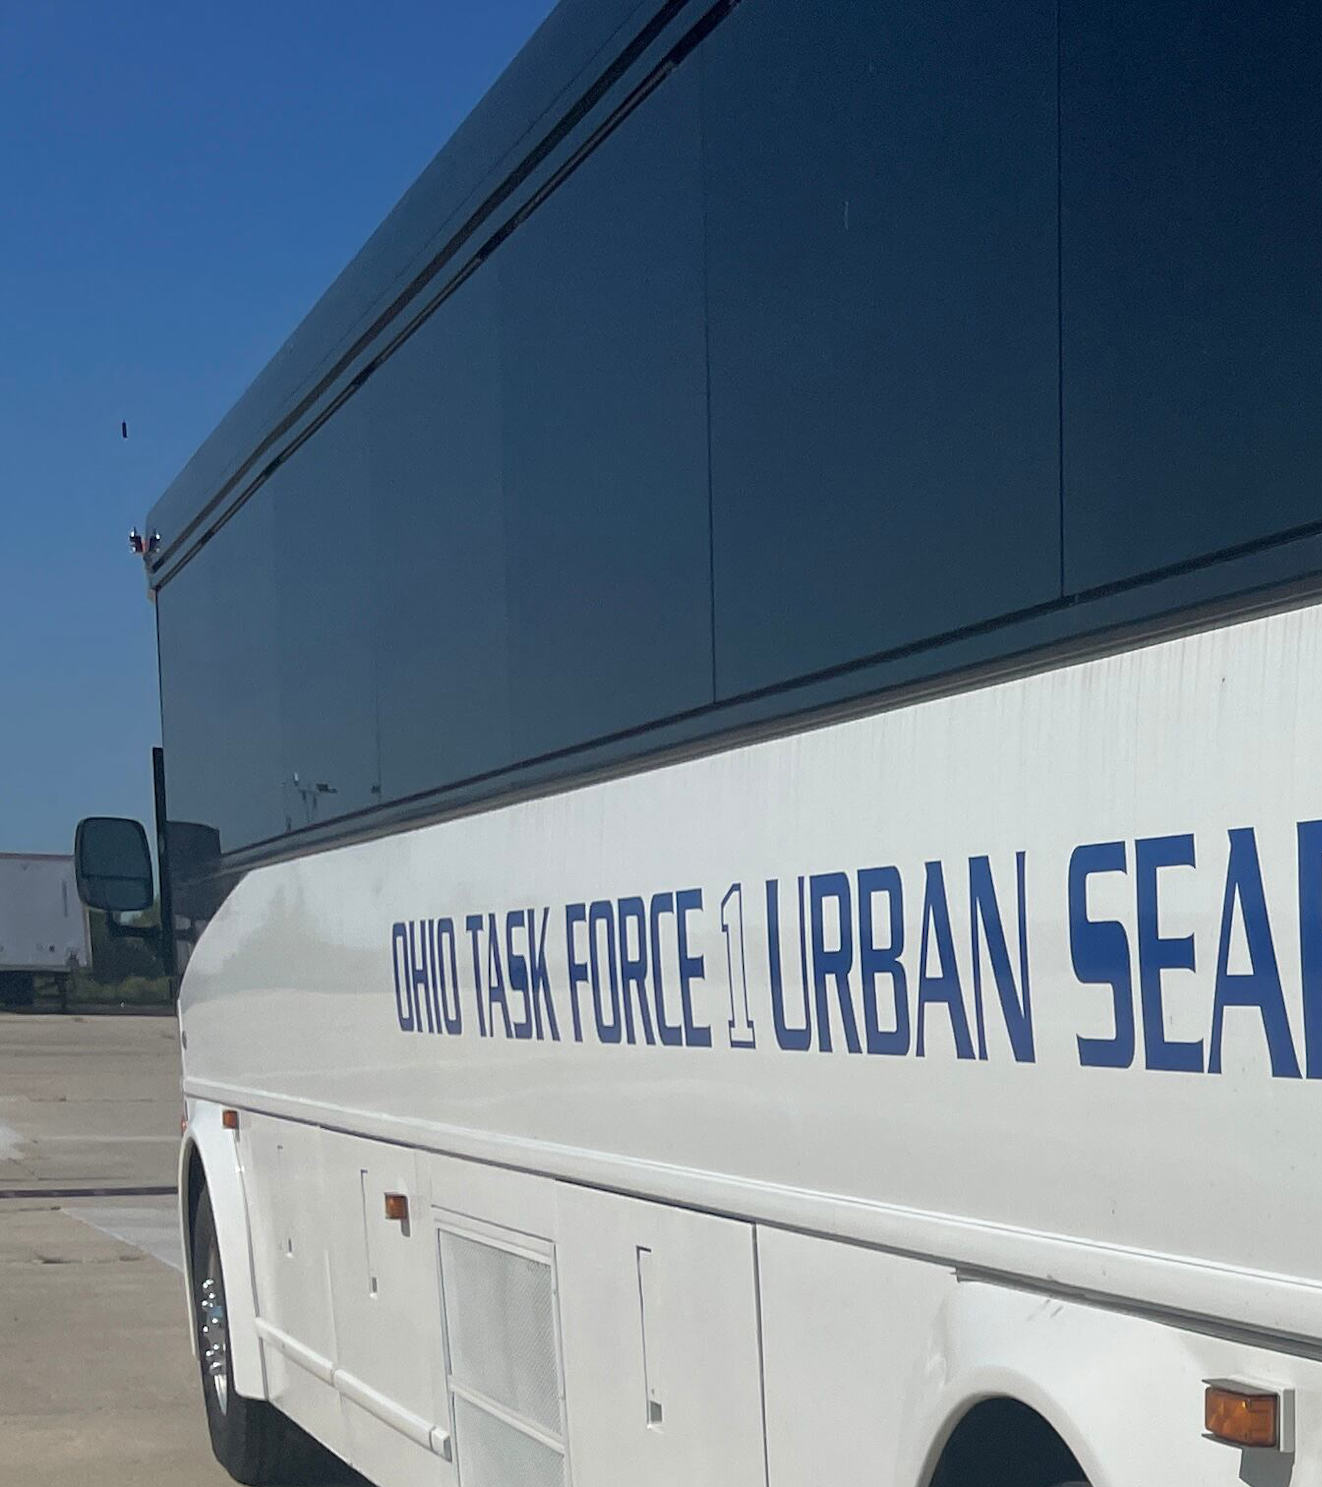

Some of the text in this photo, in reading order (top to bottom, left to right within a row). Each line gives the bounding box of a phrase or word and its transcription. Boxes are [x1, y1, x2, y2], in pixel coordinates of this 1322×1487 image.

[391, 916, 463, 1036] OHIO
[466, 905, 562, 1043] TASK
[565, 887, 713, 1048] FORCE
[720, 881, 757, 1050] 1
[765, 850, 1037, 1064] URBAN
